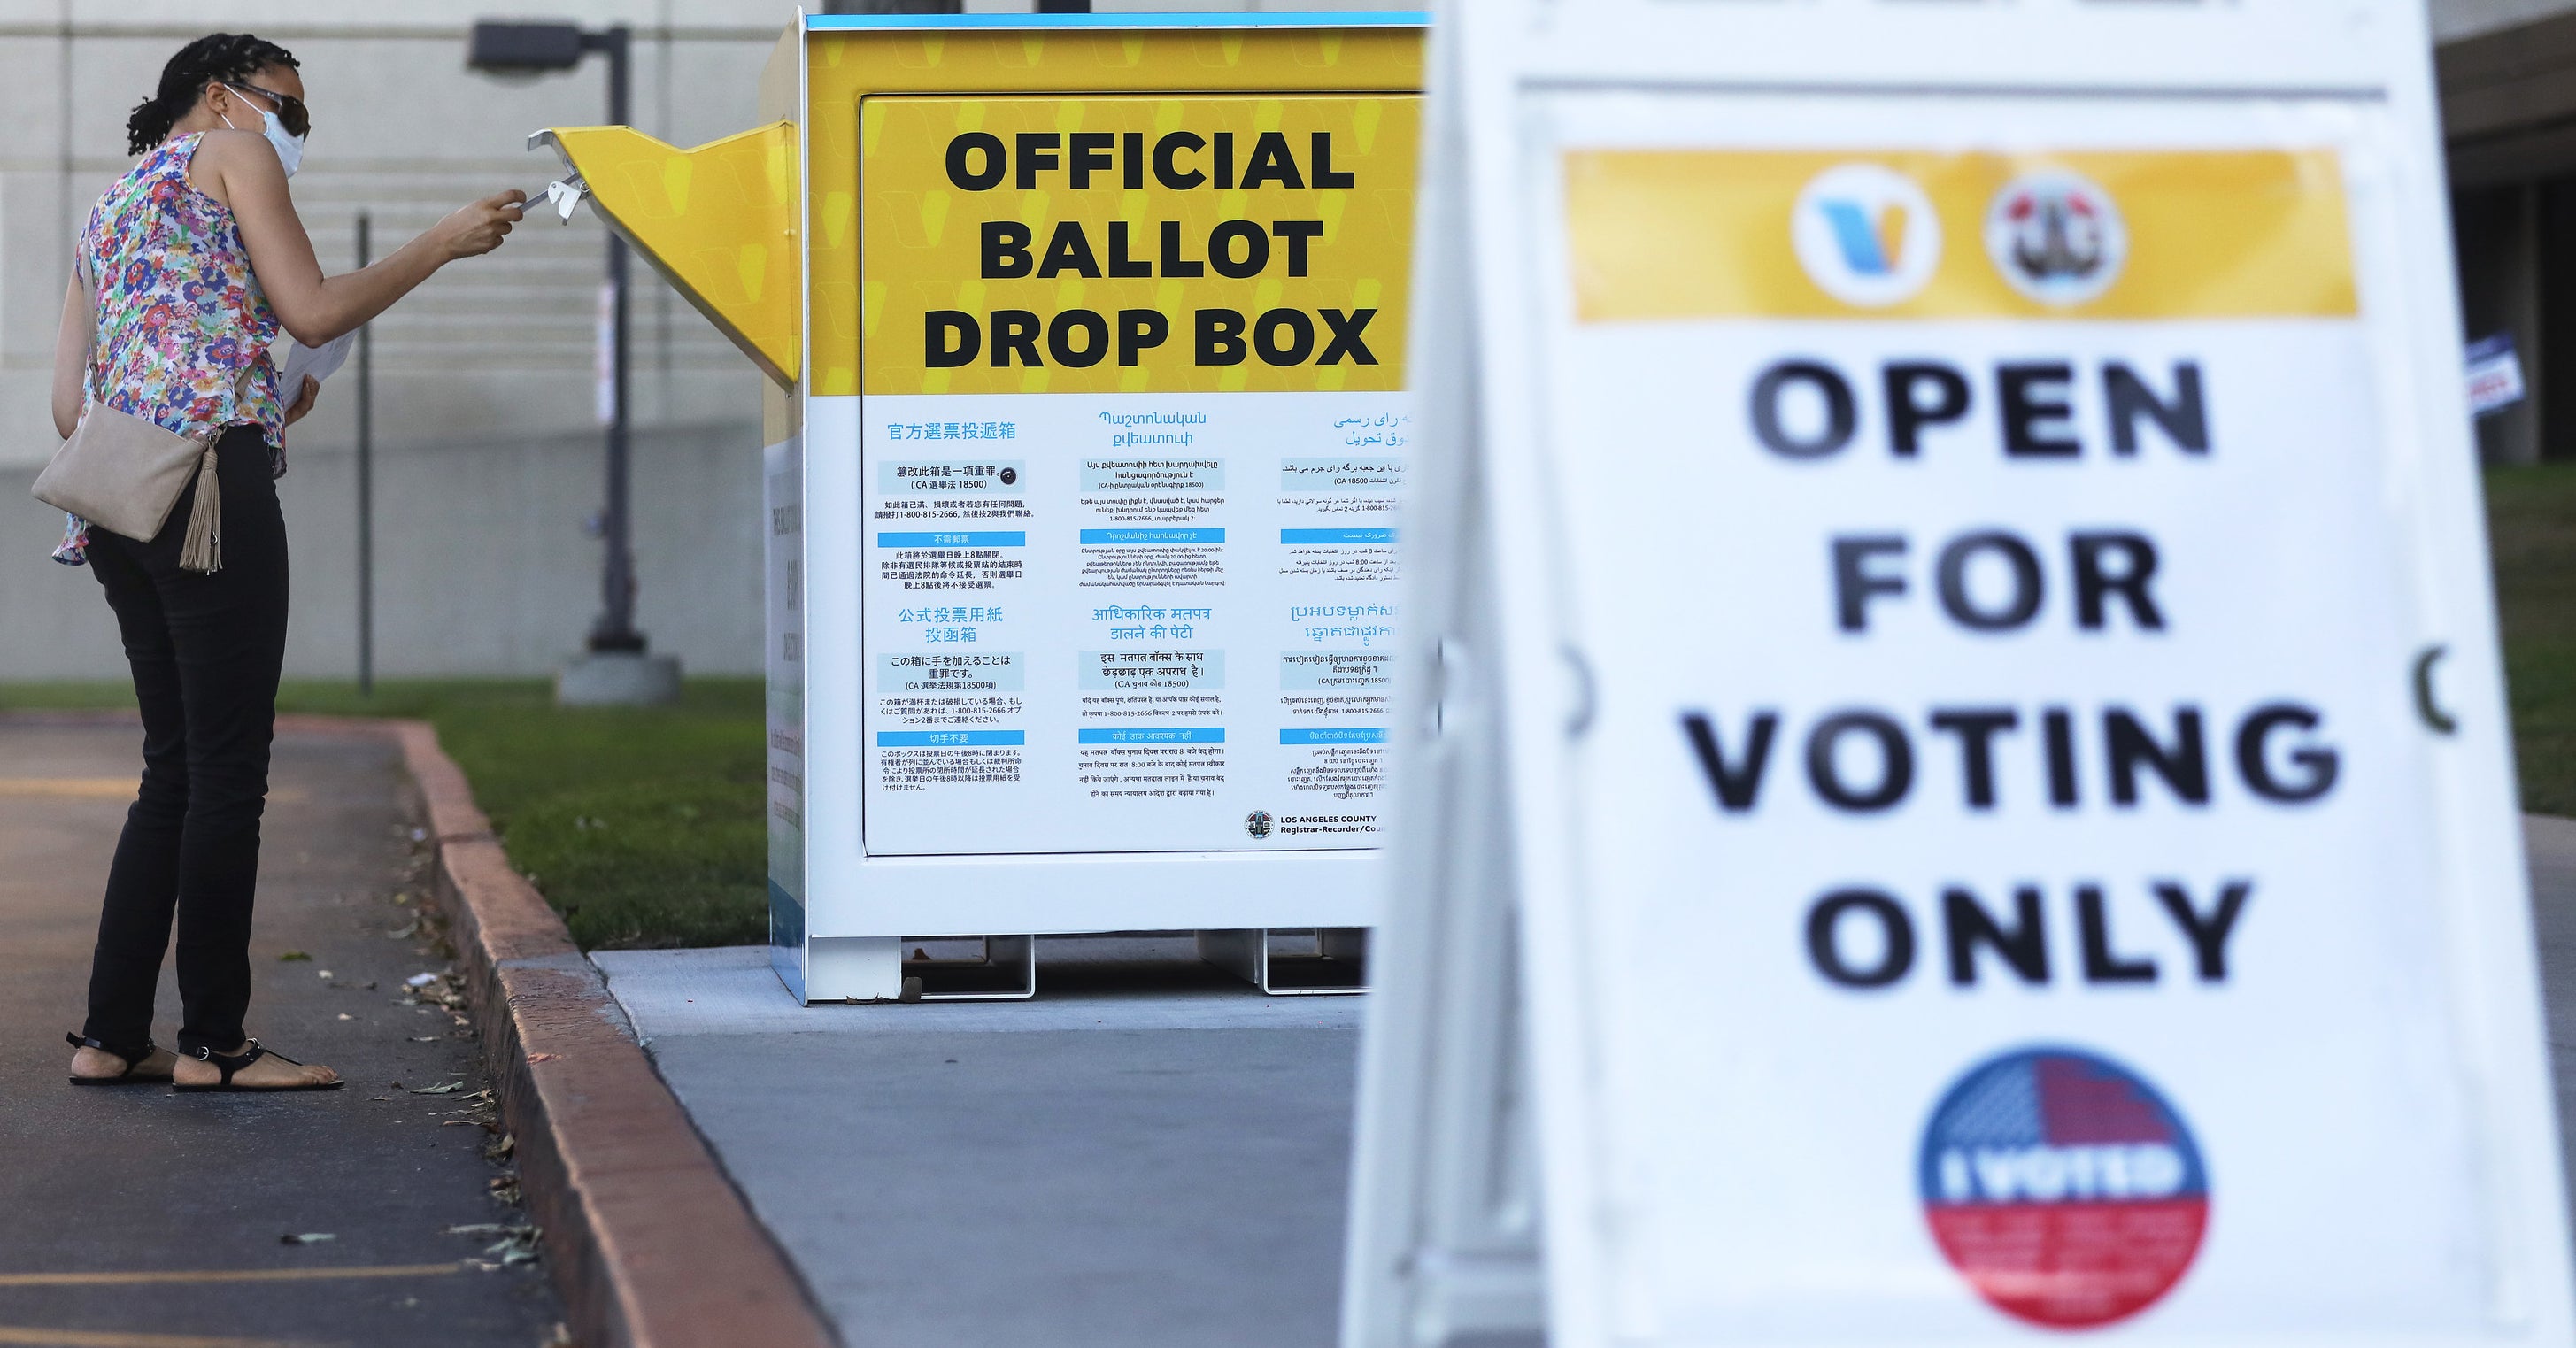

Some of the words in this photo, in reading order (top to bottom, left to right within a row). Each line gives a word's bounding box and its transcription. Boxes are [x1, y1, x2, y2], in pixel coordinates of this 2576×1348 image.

[945, 131, 1354, 191] OFFICIAL
[980, 220, 1323, 279] BALLOT
[925, 309, 1169, 368] DROP
[1194, 308, 1379, 366] BOX
[1748, 358, 2210, 459] OPEN
[1099, 412, 1206, 427] Պաշտոնական
[1334, 417, 1369, 428] رسمی
[1374, 412, 1398, 427] رای
[888, 422, 1015, 440] 官方選票投遞箱
[1346, 431, 1381, 446] تحویل
[1113, 432, 1192, 447] քվեատուփ
[1829, 528, 2167, 632] FOR
[899, 607, 1003, 623] 公式投票用紙
[1092, 605, 1167, 620] आधिकारिक
[1171, 609, 1212, 620] मतपत्र
[926, 627, 976, 643] 投函箱
[1110, 624, 1145, 639] डालने
[1150, 624, 1167, 639] की
[1170, 624, 1193, 639] पेटी
[891, 656, 1010, 666] この箱に手を加えることは
[1100, 654, 1114, 663] इस
[1174, 651, 1184, 661] के
[929, 668, 972, 679] 重罪です。
[1138, 666, 1155, 679] एक
[929, 734, 968, 743] 切手不要
[1682, 702, 2341, 813] VOTING
[1804, 878, 2254, 989] ONLY
[1940, 1145, 1971, 1202] I
